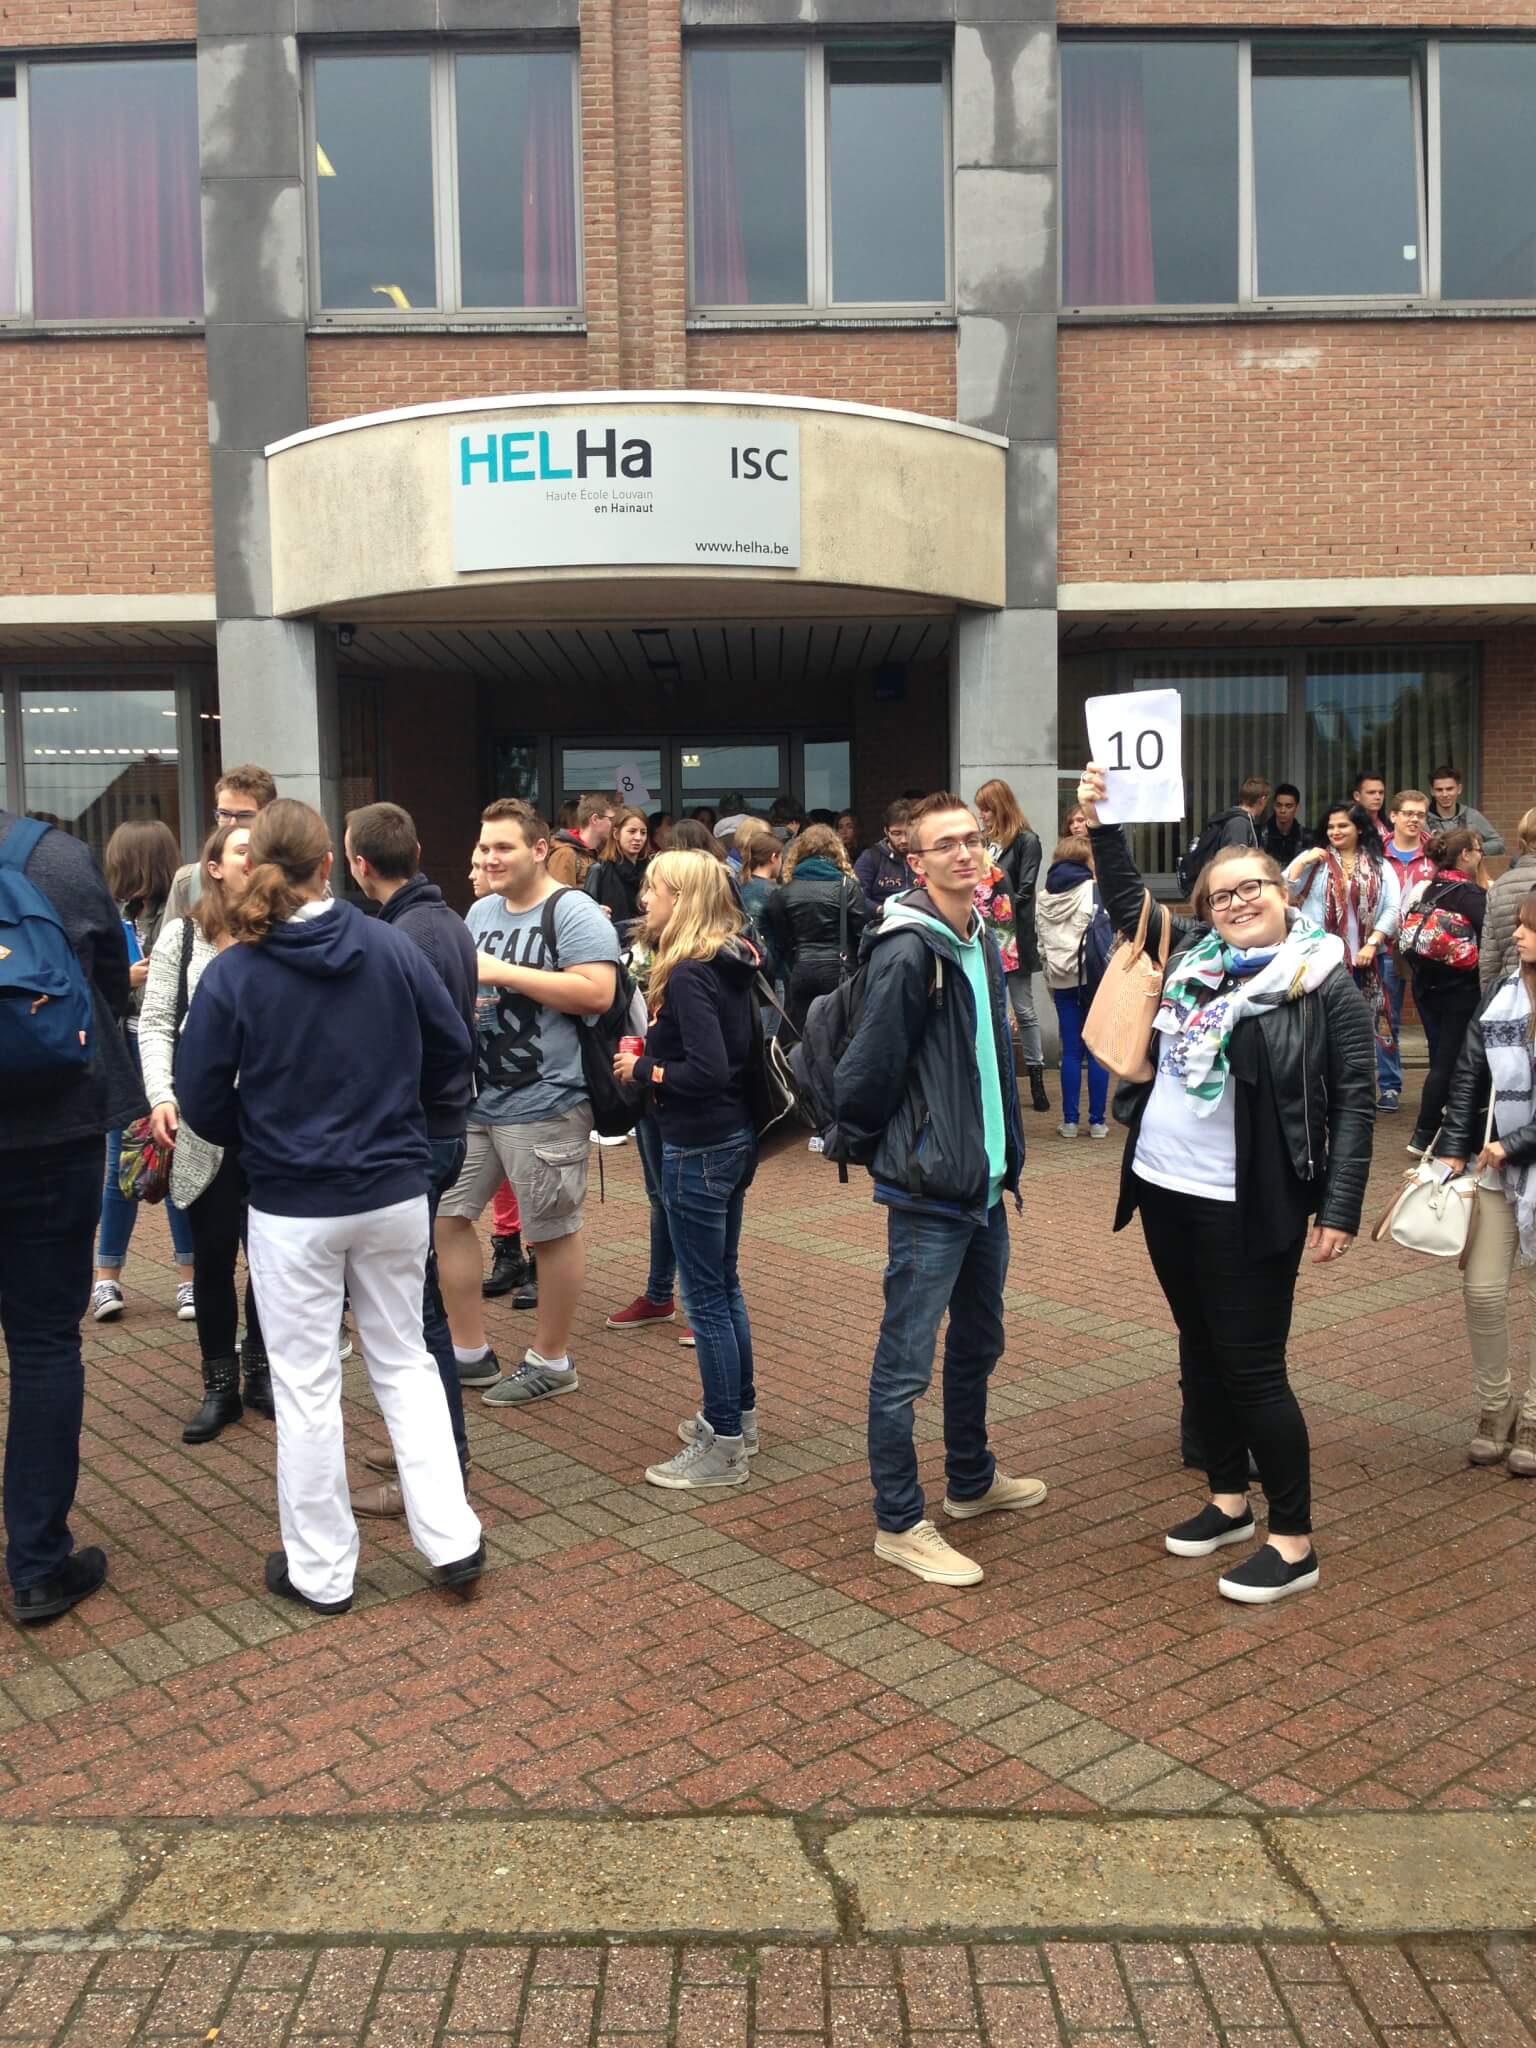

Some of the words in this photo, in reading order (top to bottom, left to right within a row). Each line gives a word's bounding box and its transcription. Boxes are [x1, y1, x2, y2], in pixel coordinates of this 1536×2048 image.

[460, 428, 652, 486] HELHa
[730, 446, 789, 482] ISC
[546, 490, 577, 502] Haute
[580, 488, 608, 501] École
[612, 488, 654, 500] Louvain
[594, 505, 608, 514] en
[611, 503, 654, 513] Hainaut
[695, 540, 789, 555] www.helha.be
[1108, 729, 1164, 771] 10
[621, 776, 634, 792] 8
